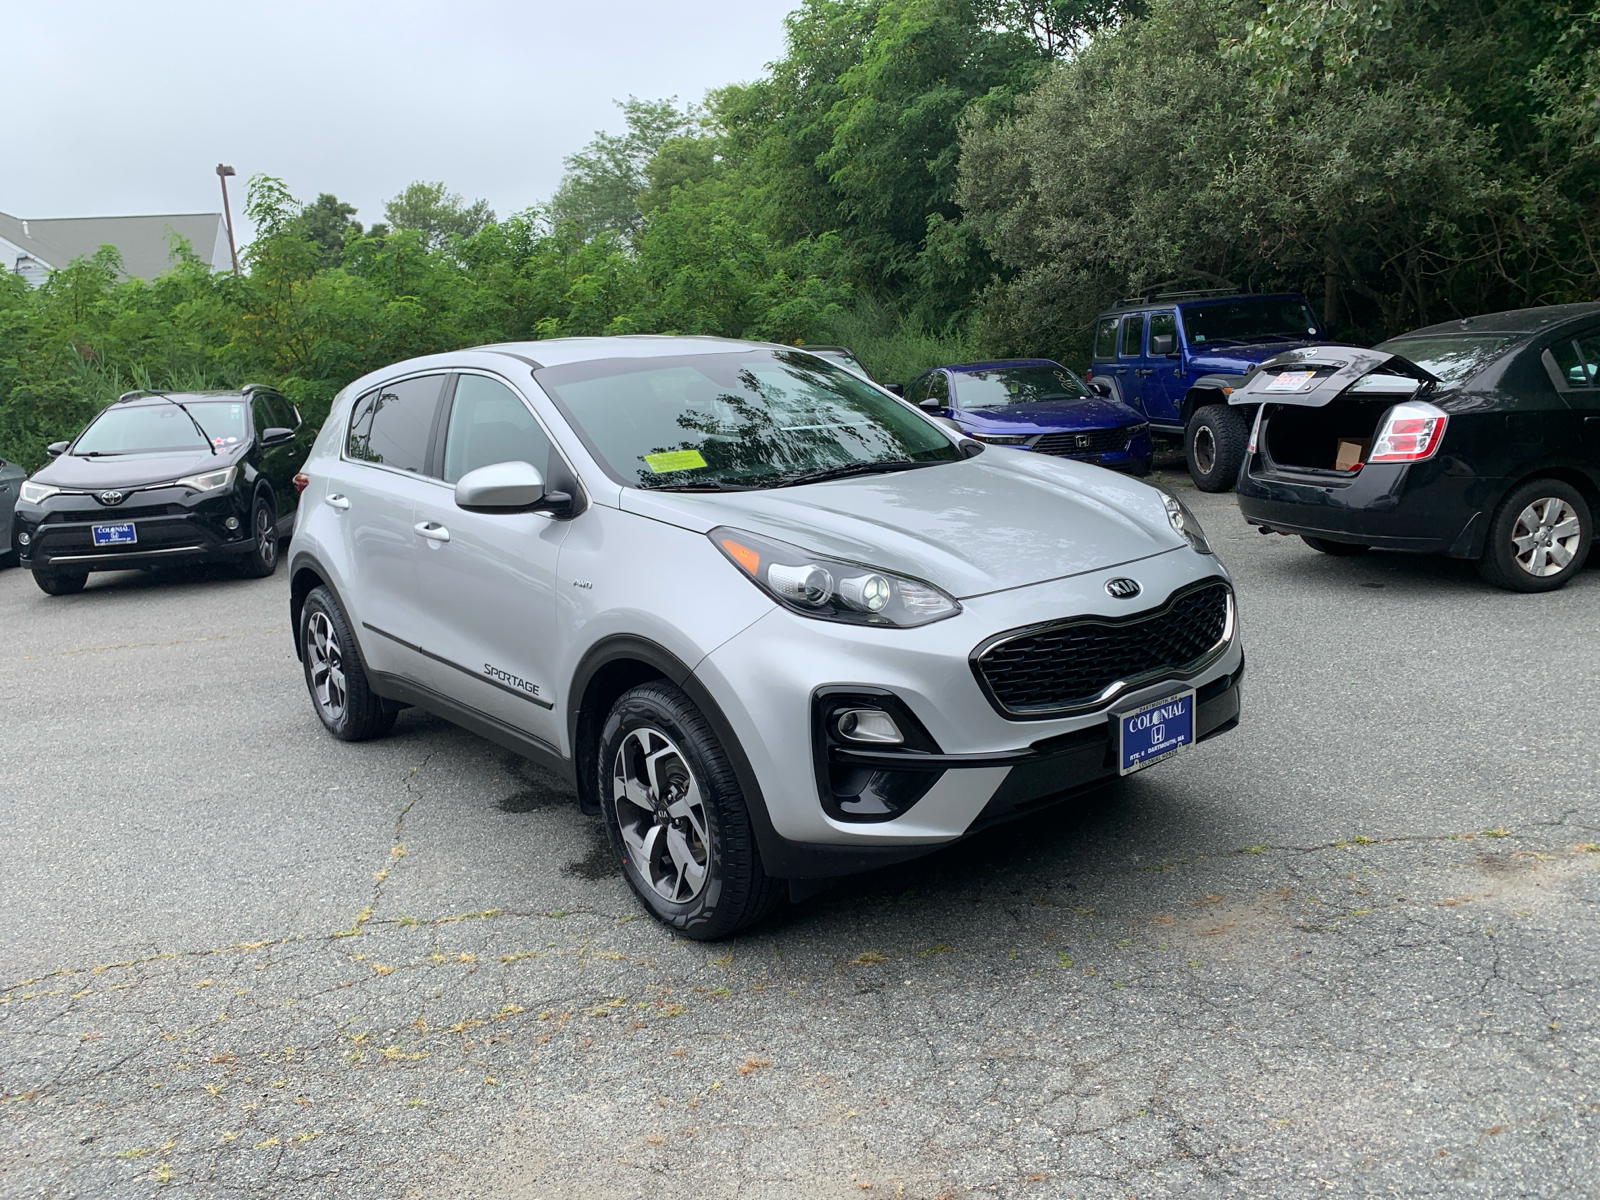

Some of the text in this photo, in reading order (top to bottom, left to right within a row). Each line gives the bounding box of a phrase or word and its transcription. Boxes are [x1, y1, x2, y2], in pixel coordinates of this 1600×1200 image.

[98, 525, 131, 534] COLONIAL
[1109, 580, 1139, 596] KIA
[484, 663, 540, 697] SPORTAGE
[1129, 701, 1186, 733] COLONIAL
[1177, 734, 1185, 742] MA
